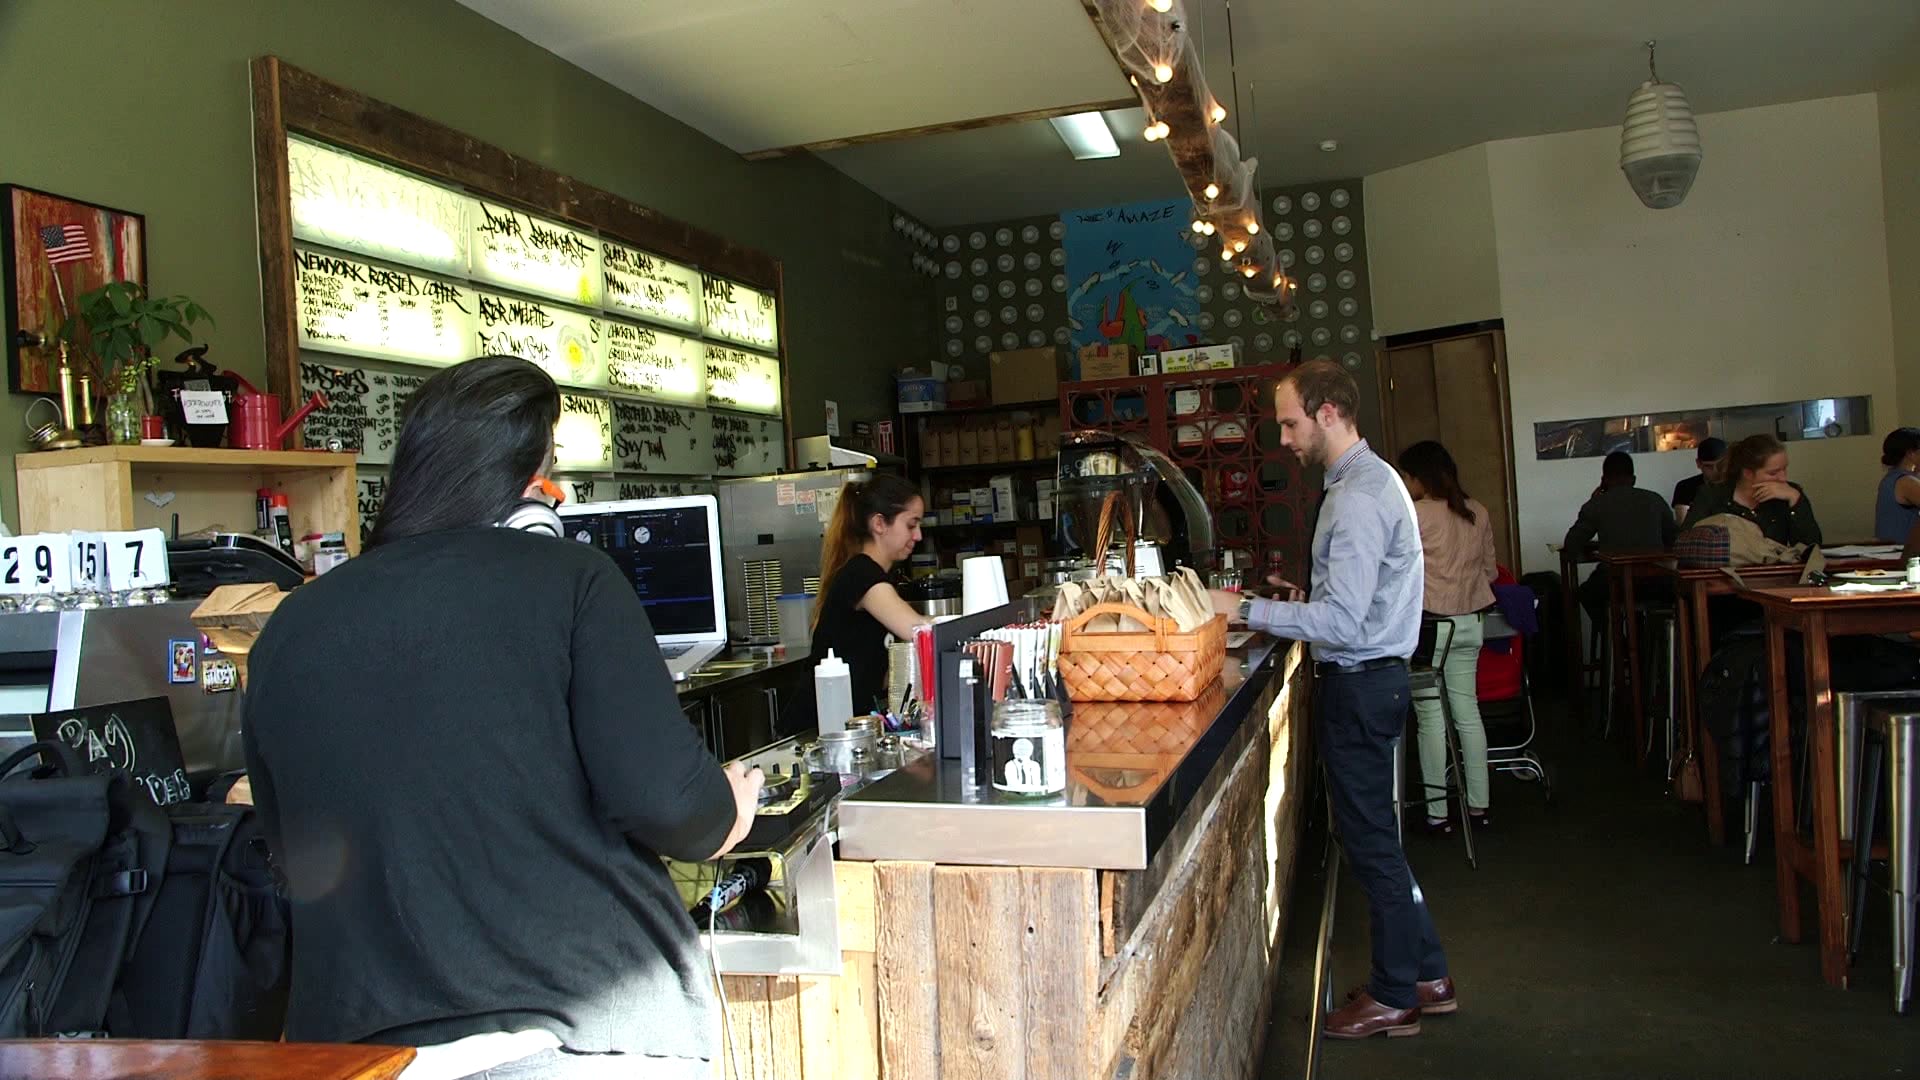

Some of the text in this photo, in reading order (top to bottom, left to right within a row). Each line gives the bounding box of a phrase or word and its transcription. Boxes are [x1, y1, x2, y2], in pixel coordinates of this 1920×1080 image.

[368, 265, 419, 296] ROASTED
[701, 272, 736, 303] MAINE
[3, 547, 20, 584] 2
[34, 545, 53, 584] 9
[77, 541, 97, 580] 15
[125, 540, 144, 578] 7
